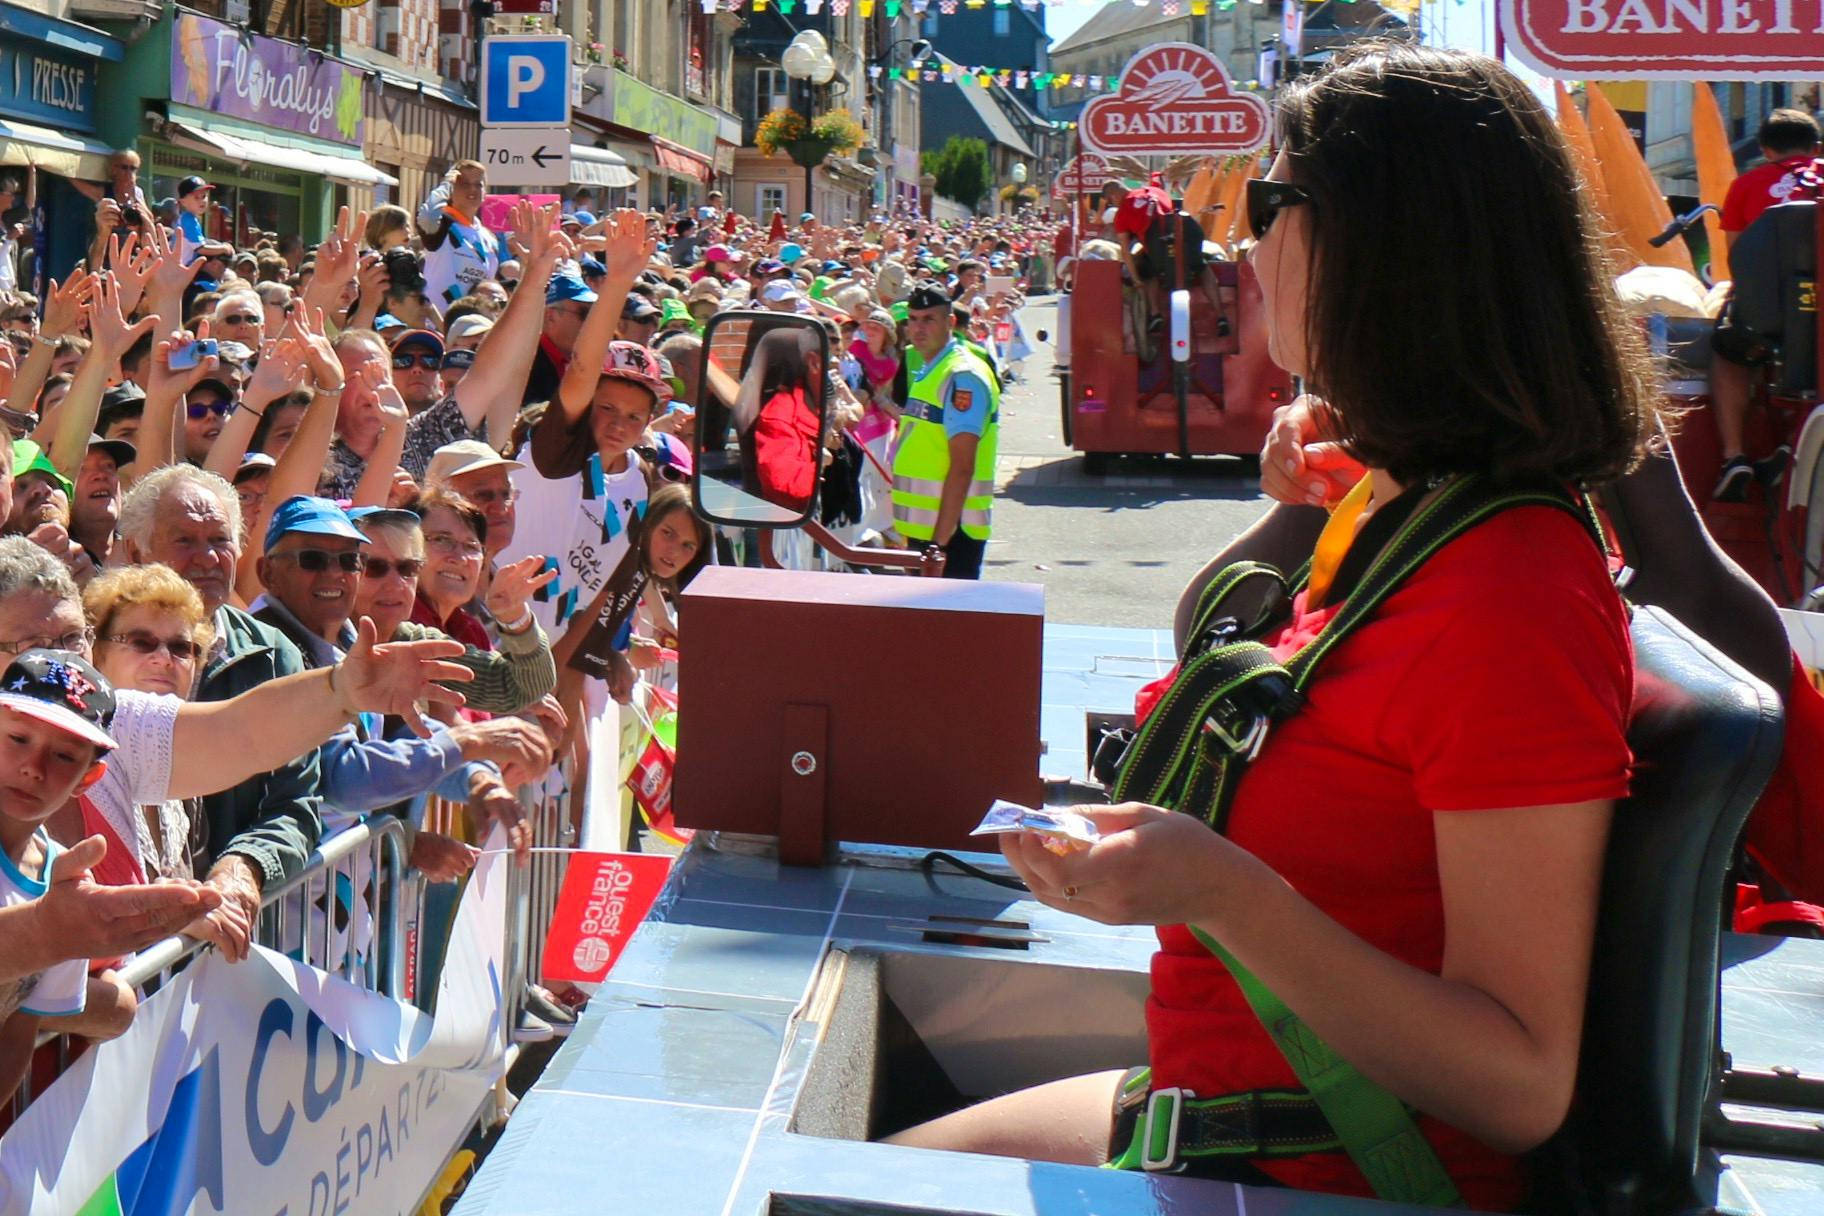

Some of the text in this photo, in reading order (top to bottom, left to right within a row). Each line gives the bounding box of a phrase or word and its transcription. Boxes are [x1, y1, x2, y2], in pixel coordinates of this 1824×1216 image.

[32, 56, 84, 112] PRESSE
[215, 29, 335, 134] Floralys
[507, 55, 545, 109] P
[1104, 112, 1247, 135] BANETTE
[487, 149, 524, 164] 70 m
[580, 860, 623, 934] france
[597, 870, 633, 936] ouest
